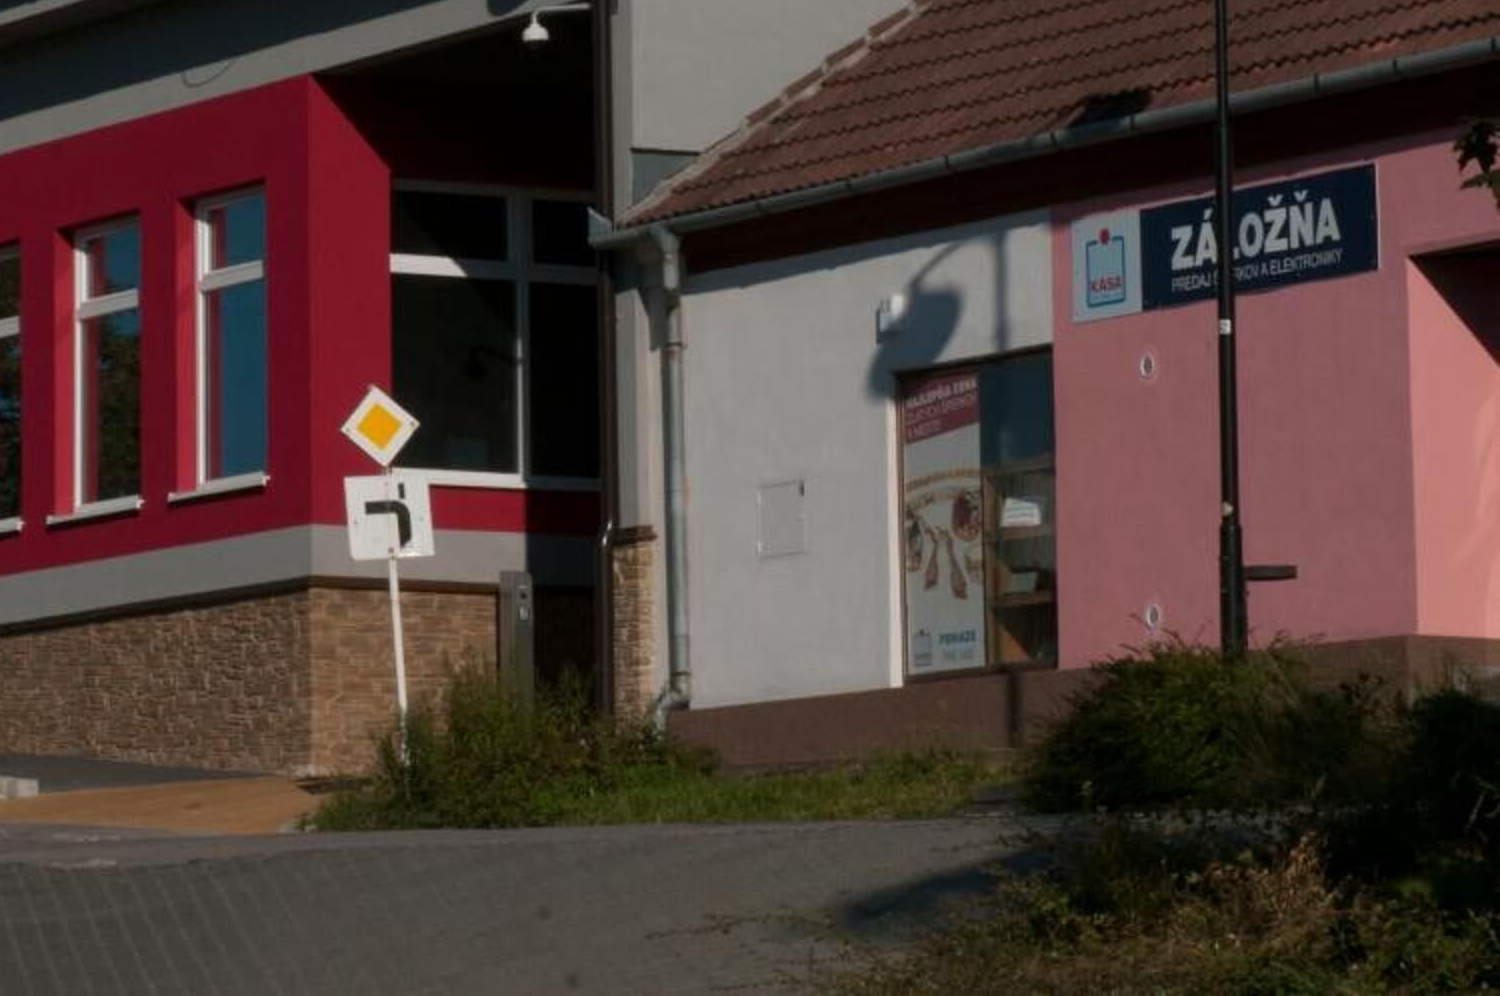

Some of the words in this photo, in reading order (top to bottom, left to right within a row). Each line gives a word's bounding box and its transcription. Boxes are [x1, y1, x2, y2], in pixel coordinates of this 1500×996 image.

[1171, 189, 1341, 271] ZÁOŽŇA
[1171, 271, 1212, 293] PREDAJ
[1269, 248, 1343, 276] ELEKTRONIKY
